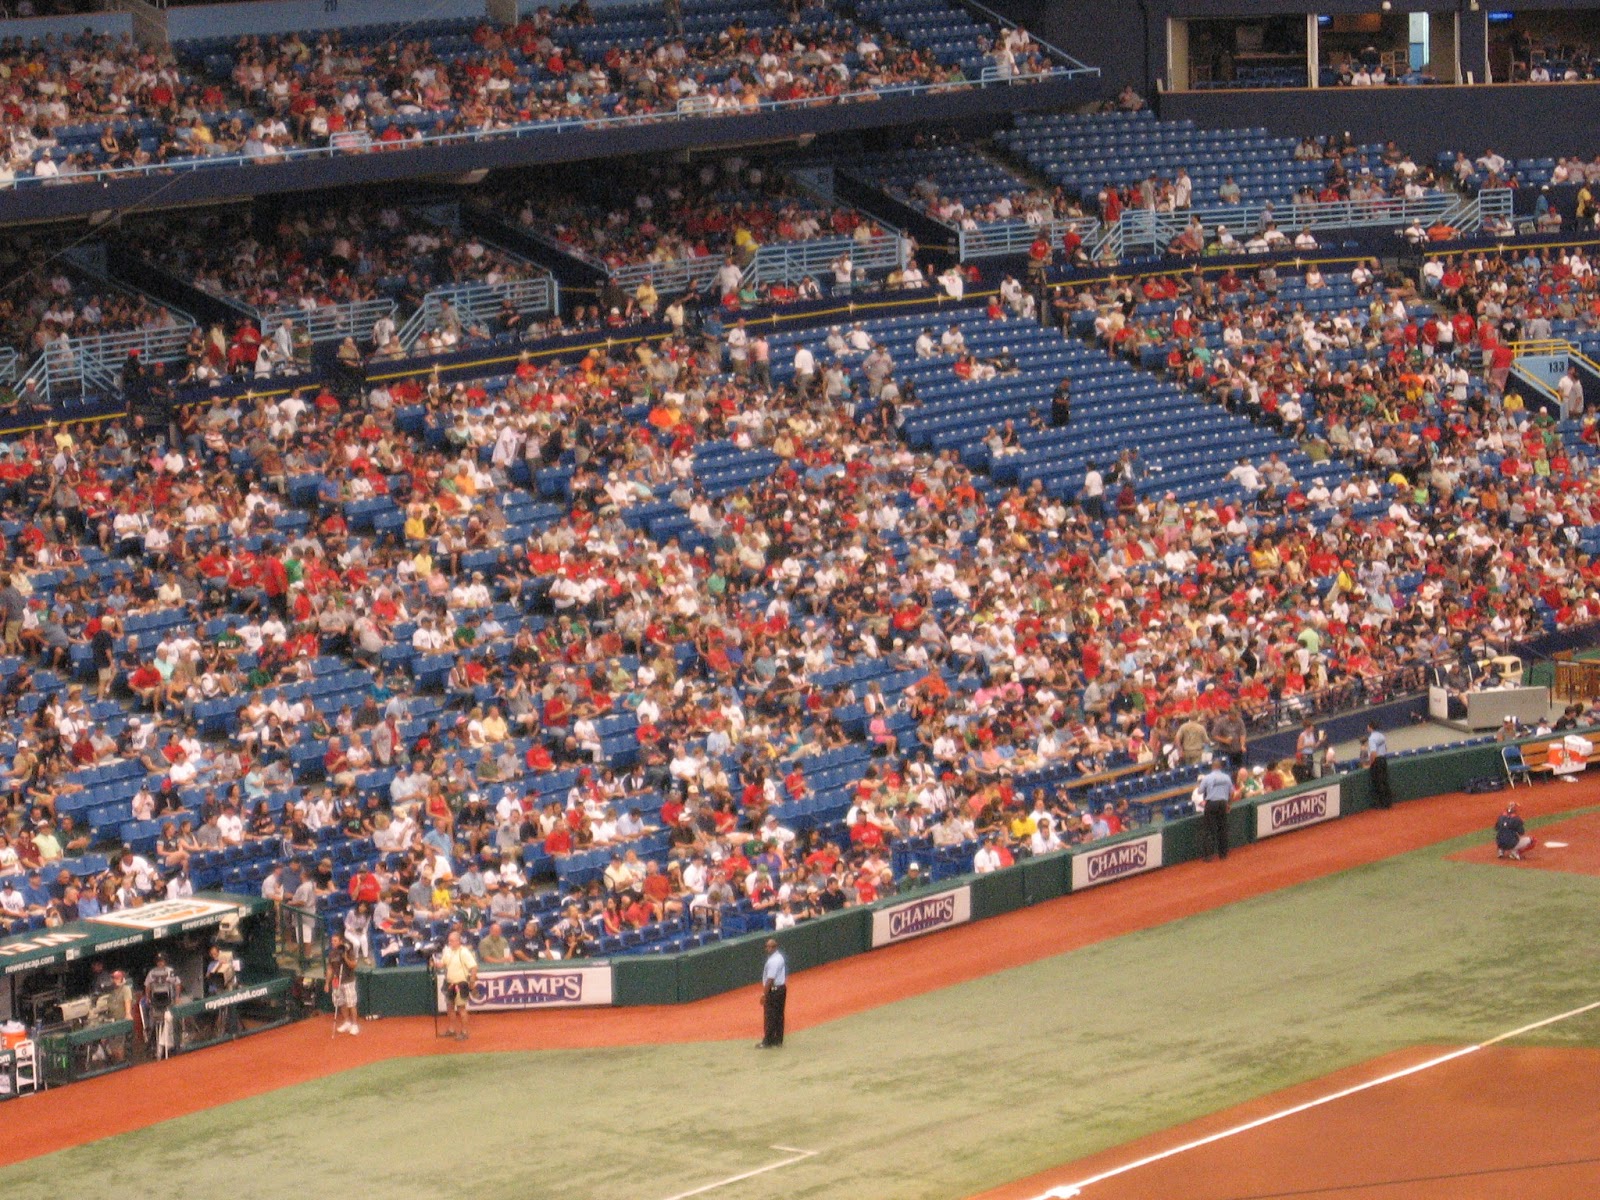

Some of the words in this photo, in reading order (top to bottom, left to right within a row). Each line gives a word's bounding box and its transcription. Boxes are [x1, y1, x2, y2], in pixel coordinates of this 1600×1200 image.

[1549, 361, 1565, 373] 133
[1272, 794, 1327, 828] CHAMPS
[1088, 844, 1147, 879] CHAMPS
[890, 898, 954, 936] CHAMPS
[5, 955, 55, 974] neweracap.com
[469, 976, 581, 1004] CHAMPS
